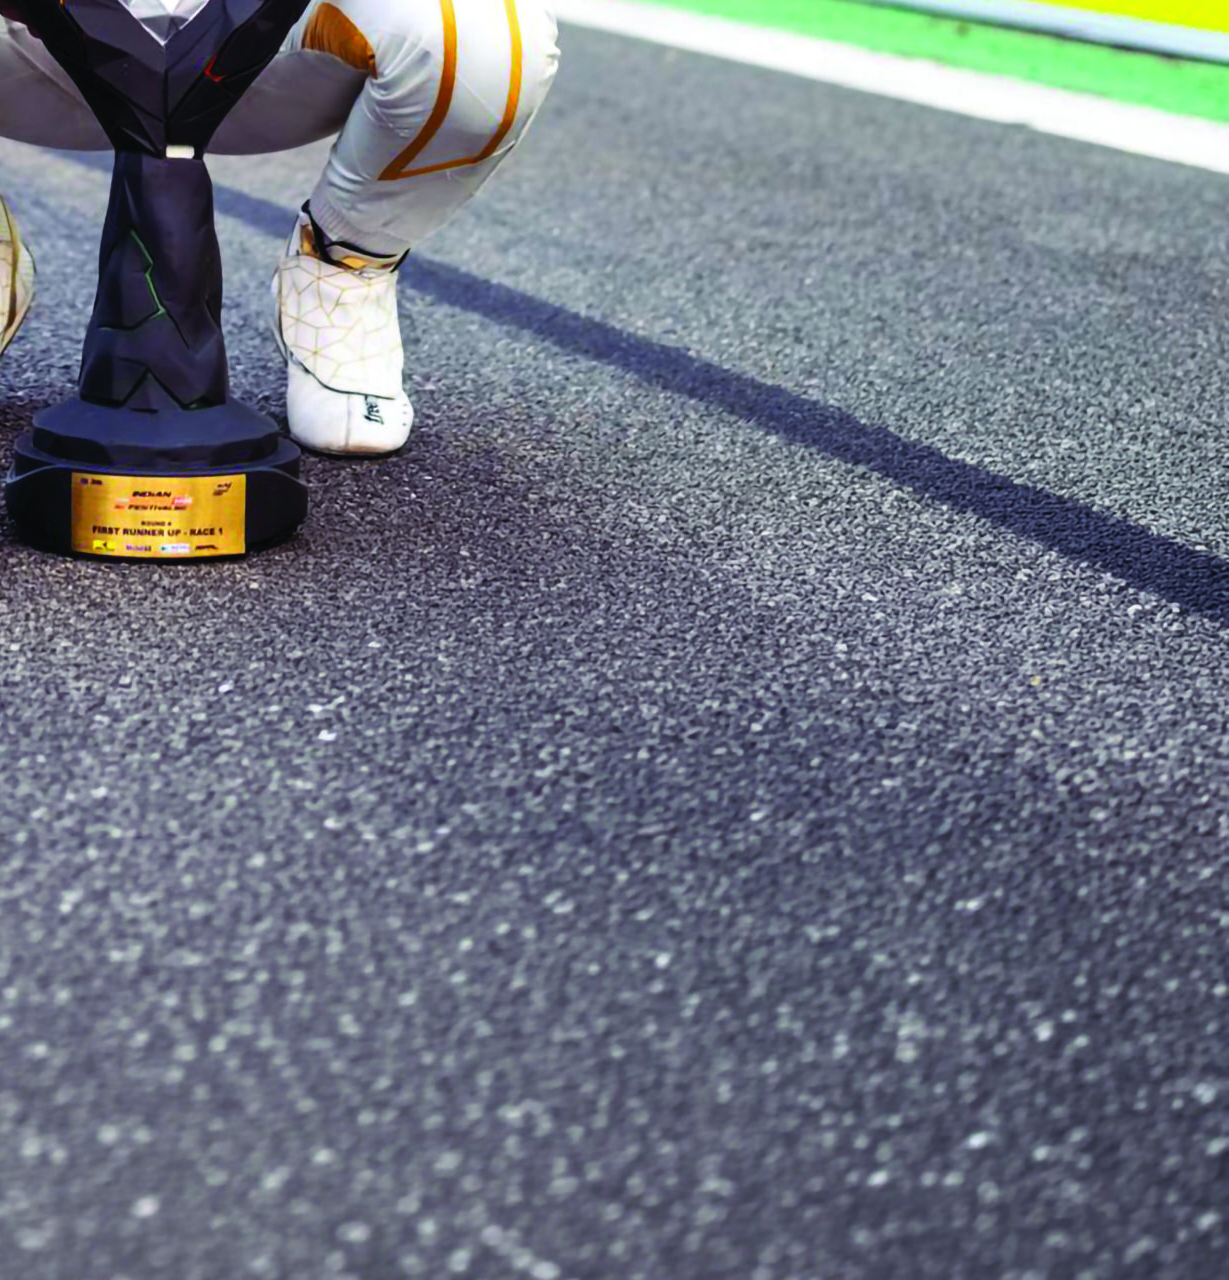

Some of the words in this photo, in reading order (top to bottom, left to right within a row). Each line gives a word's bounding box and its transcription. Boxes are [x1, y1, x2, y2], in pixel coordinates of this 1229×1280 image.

[92, 526, 120, 535] FIRST
[122, 528, 165, 537] RUNNER
[167, 529, 182, 537] UP
[189, 527, 215, 536] RACE
